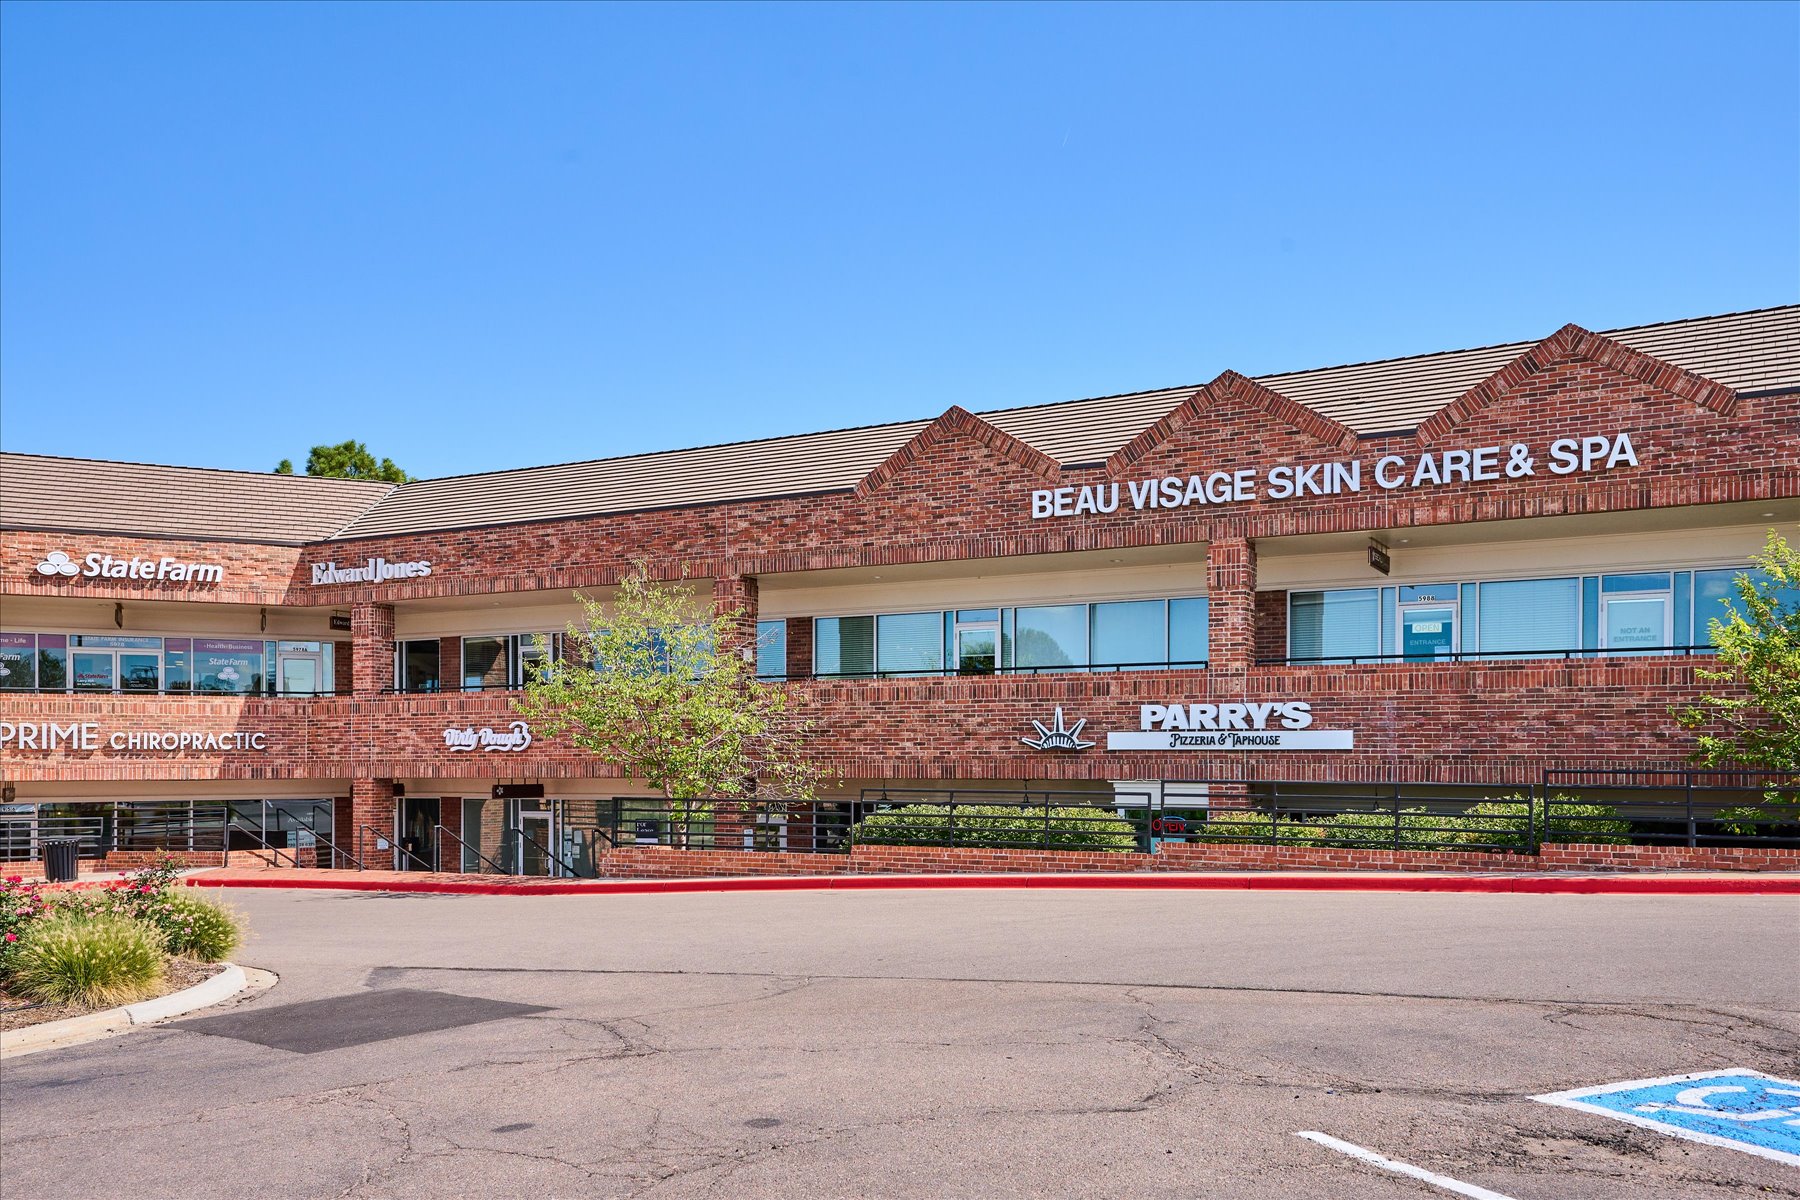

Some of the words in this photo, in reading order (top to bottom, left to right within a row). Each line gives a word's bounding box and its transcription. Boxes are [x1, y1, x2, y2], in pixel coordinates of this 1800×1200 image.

[1032, 483, 1120, 519] BEAU
[1128, 469, 1257, 510] VISAGE
[1268, 459, 1362, 499] SKIN
[1374, 446, 1500, 490] CARE
[1548, 433, 1639, 475] SPA
[1414, 623, 1440, 632] OPEN
[1140, 701, 1313, 730] PARRY'S
[0, 722, 99, 750] PRIME
[110, 732, 266, 751] CHIROPRACTIC
[443, 728, 480, 752] Dirty
[479, 721, 532, 752] Dough
[1169, 733, 1216, 748] PIZZERIA
[1218, 733, 1227, 746] &
[1228, 732, 1281, 748] TAPHOUSE
